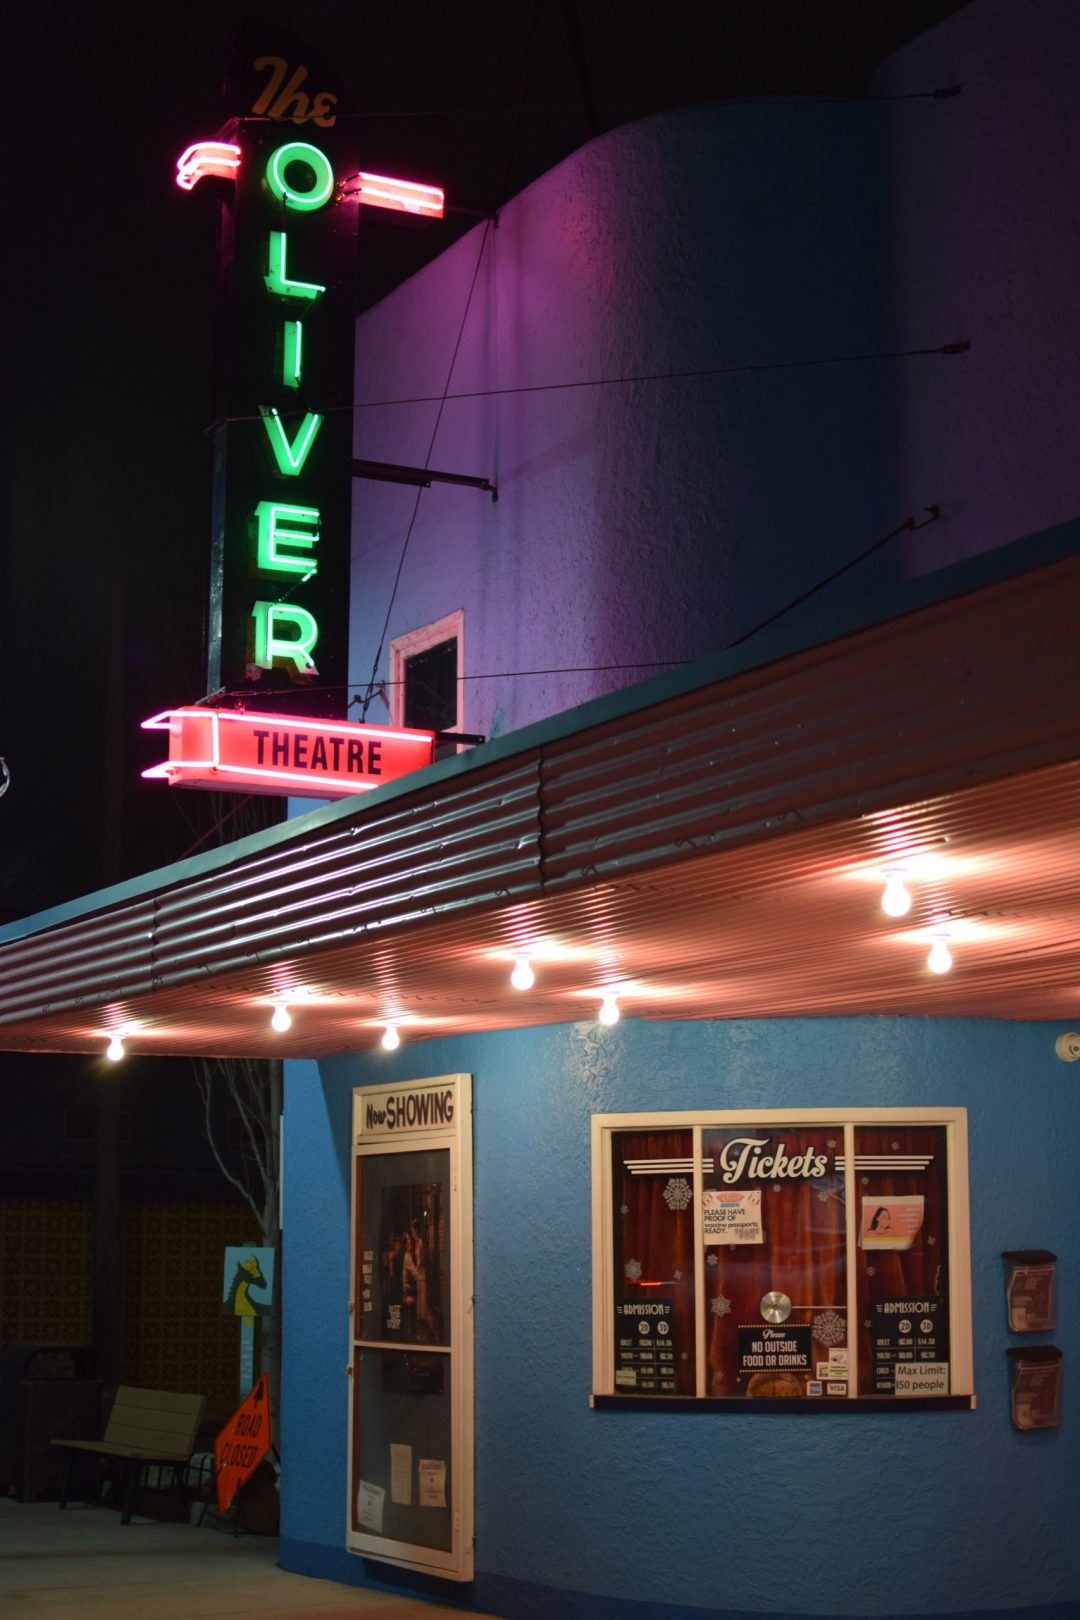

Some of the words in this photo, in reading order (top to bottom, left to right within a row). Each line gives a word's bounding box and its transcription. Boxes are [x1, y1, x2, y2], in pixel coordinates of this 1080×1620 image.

[250, 142, 334, 676] OLIVER
[253, 730, 382, 775] THEATRE
[366, 1103, 387, 1129] Now
[386, 1090, 454, 1129] SHOWING
[720, 1138, 828, 1183] Tickets
[623, 1304, 665, 1315] ADMISSION
[884, 1302, 930, 1313] ADMISSION
[751, 1342, 763, 1352] NO
[765, 1341, 798, 1352] OUTSIDE
[743, 1356, 764, 1366] FOOD
[766, 1356, 777, 1366] OR
[779, 1355, 806, 1366] DRINKS
[898, 1366, 917, 1375] Max
[920, 1366, 946, 1375] Limit:
[912, 1380, 944, 1390] people
[233, 1414, 263, 1438] ROAD
[220, 1444, 258, 1468] CLOSED
